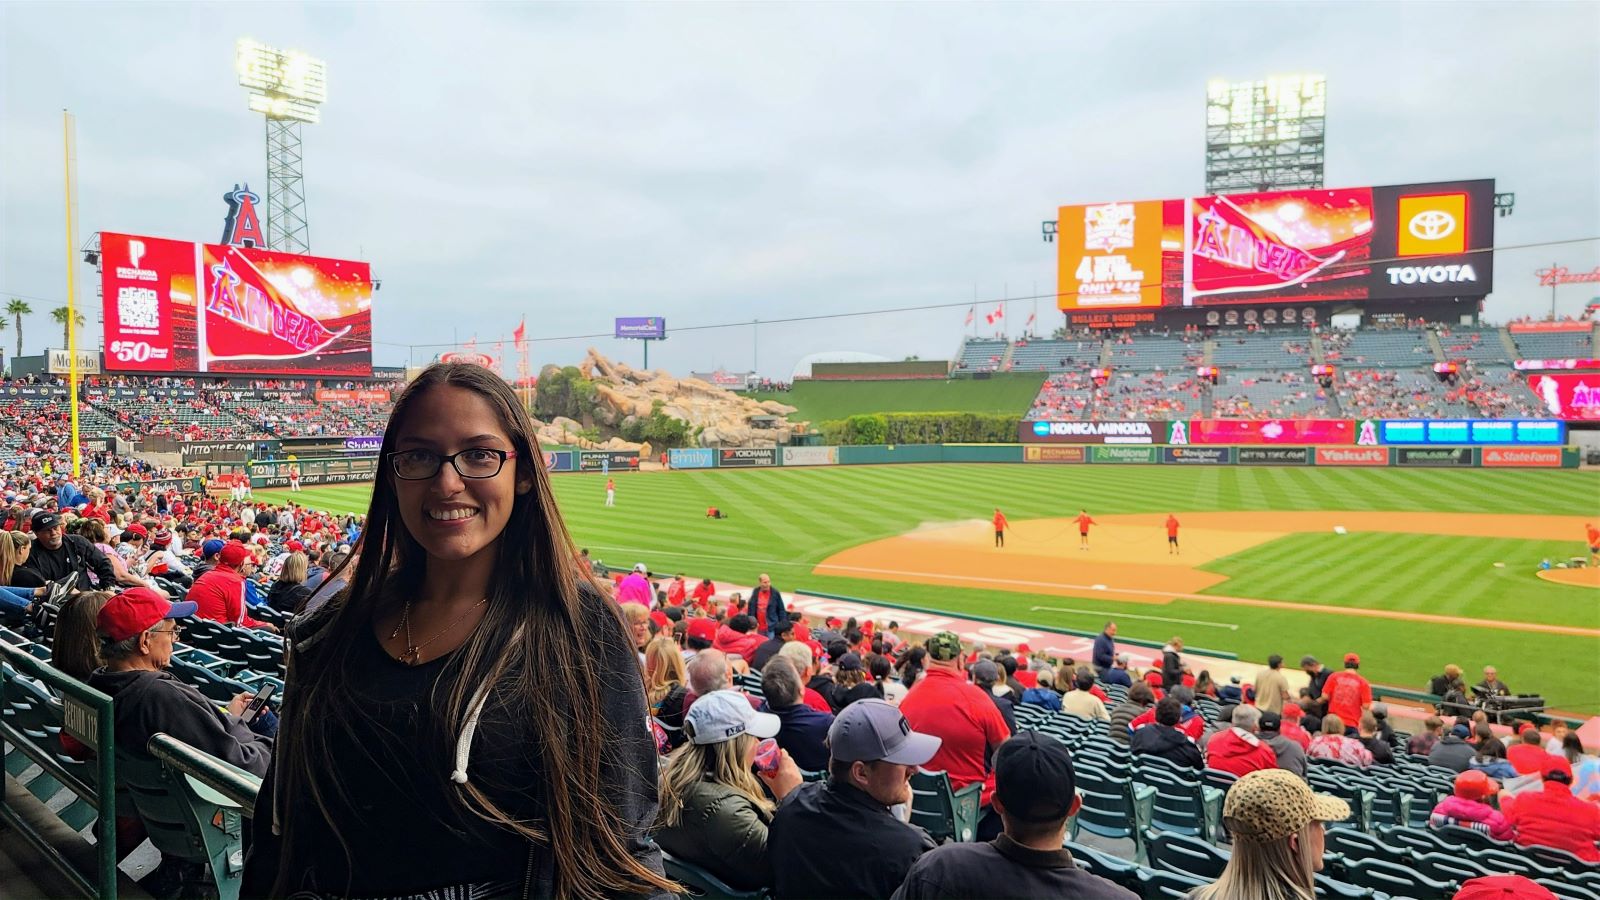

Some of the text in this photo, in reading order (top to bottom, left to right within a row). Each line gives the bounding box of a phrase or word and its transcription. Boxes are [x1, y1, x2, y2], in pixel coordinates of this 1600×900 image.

[230, 182, 268, 248] A
[1386, 264, 1477, 285] TOYOTA
[111, 340, 151, 362] $50
[1050, 422, 1152, 435] KONICA MINOLTA
[669, 450, 708, 465] emily
[735, 450, 772, 458] YOKOHAMA
[1110, 448, 1151, 458] National
[1321, 450, 1384, 462] Yakult
[326, 474, 348, 482] NITTO
[64, 699, 97, 745] SECTION 112
